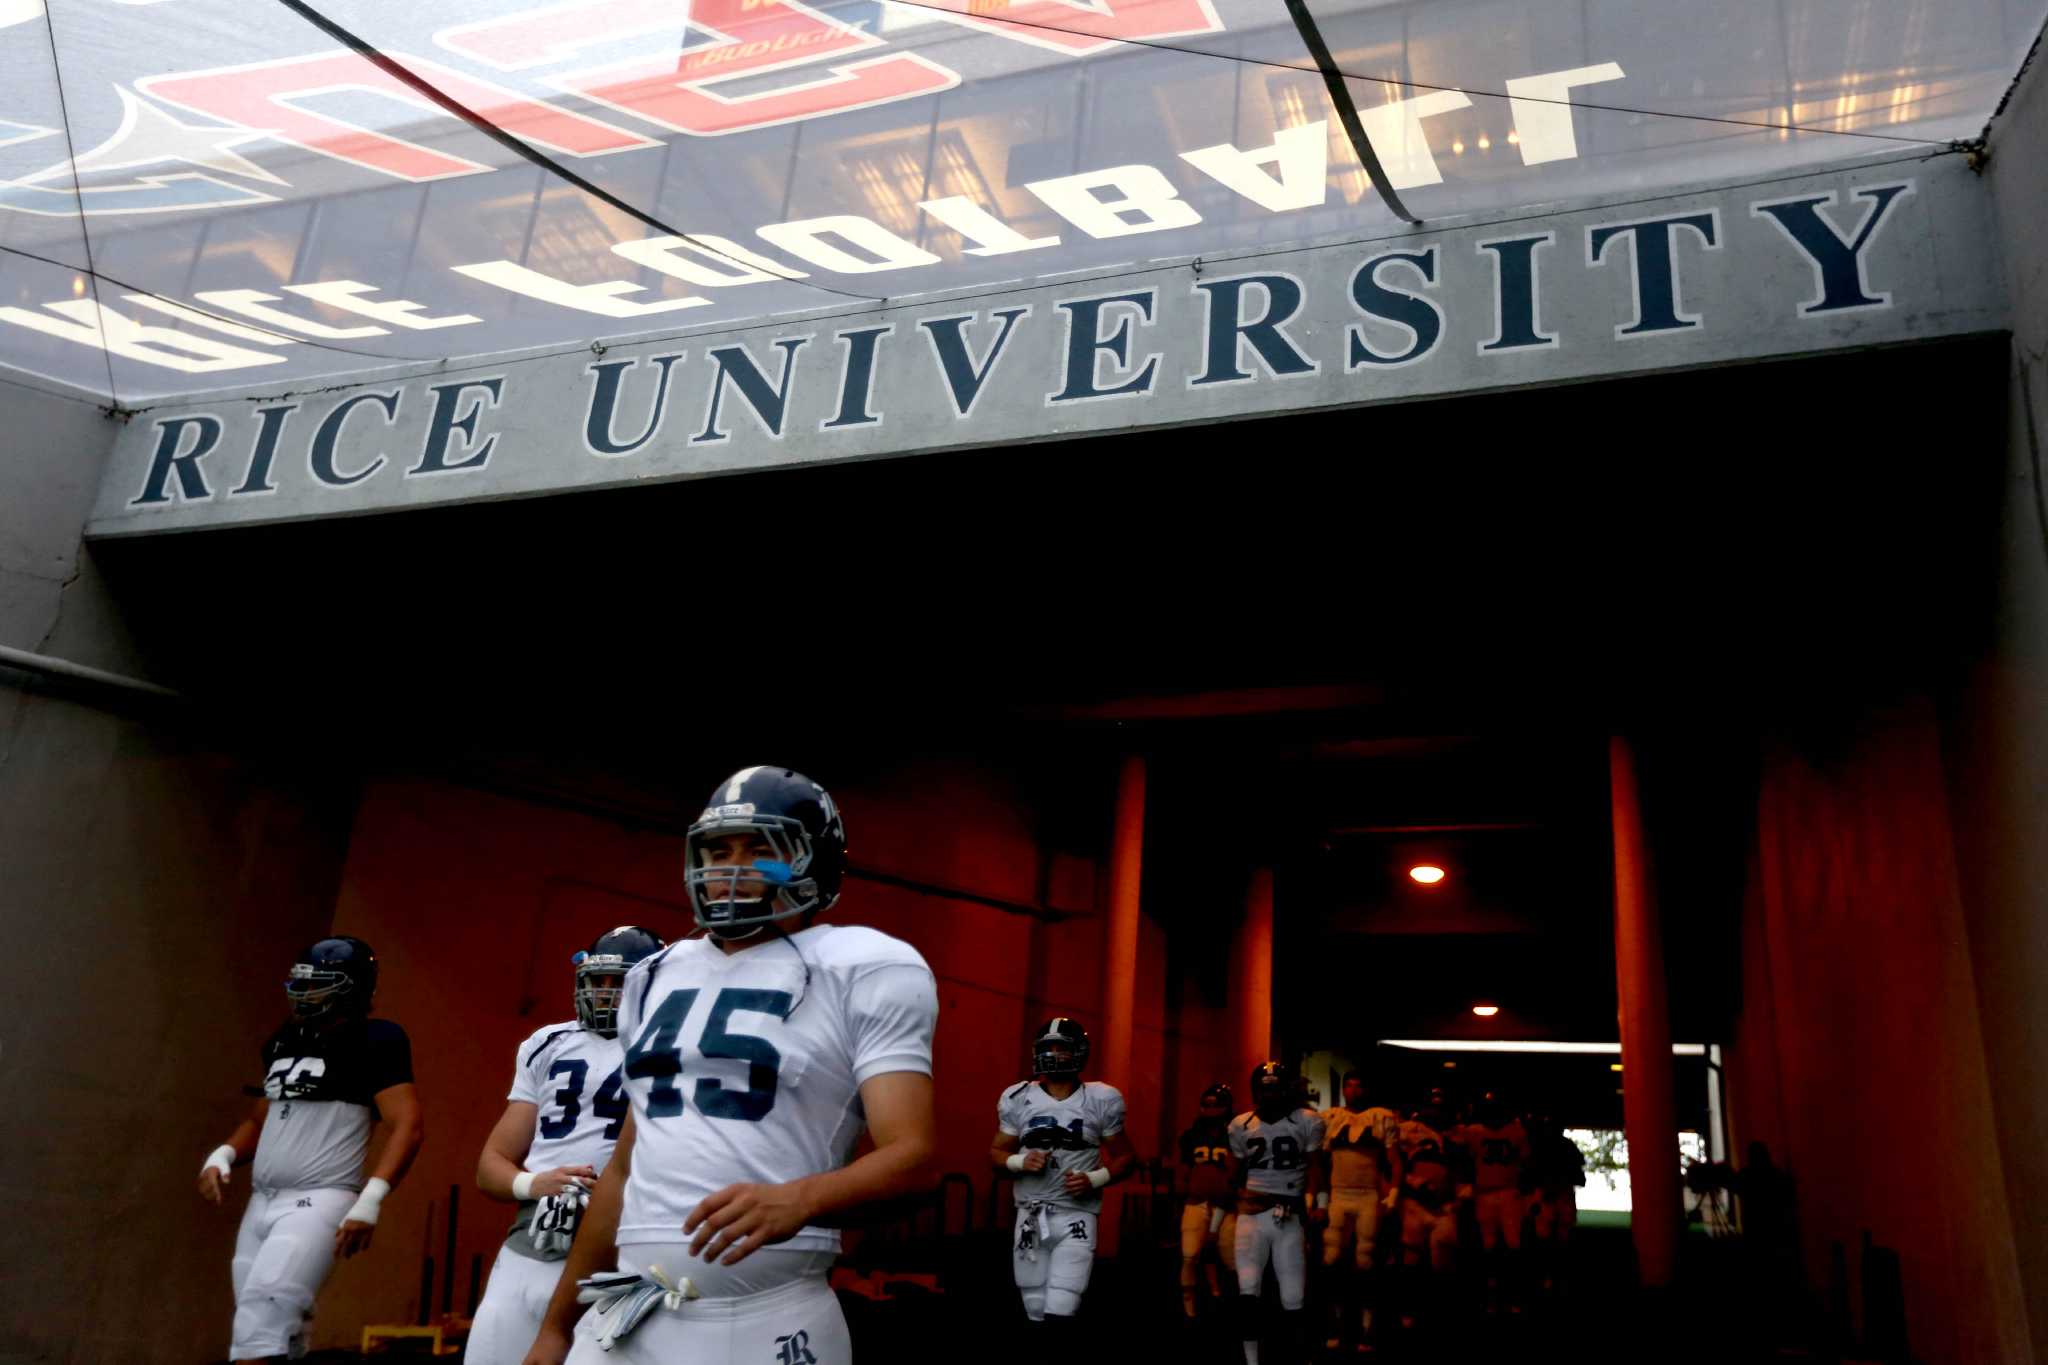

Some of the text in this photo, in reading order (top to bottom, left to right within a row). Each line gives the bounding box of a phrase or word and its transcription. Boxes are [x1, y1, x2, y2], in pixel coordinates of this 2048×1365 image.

[125, 180, 1917, 509] RICE UNIVERSITY
[625, 988, 795, 1121] 45
[540, 1059, 630, 1141] 34
[1246, 1135, 1300, 1169] 28
[775, 1329, 817, 1365] R
